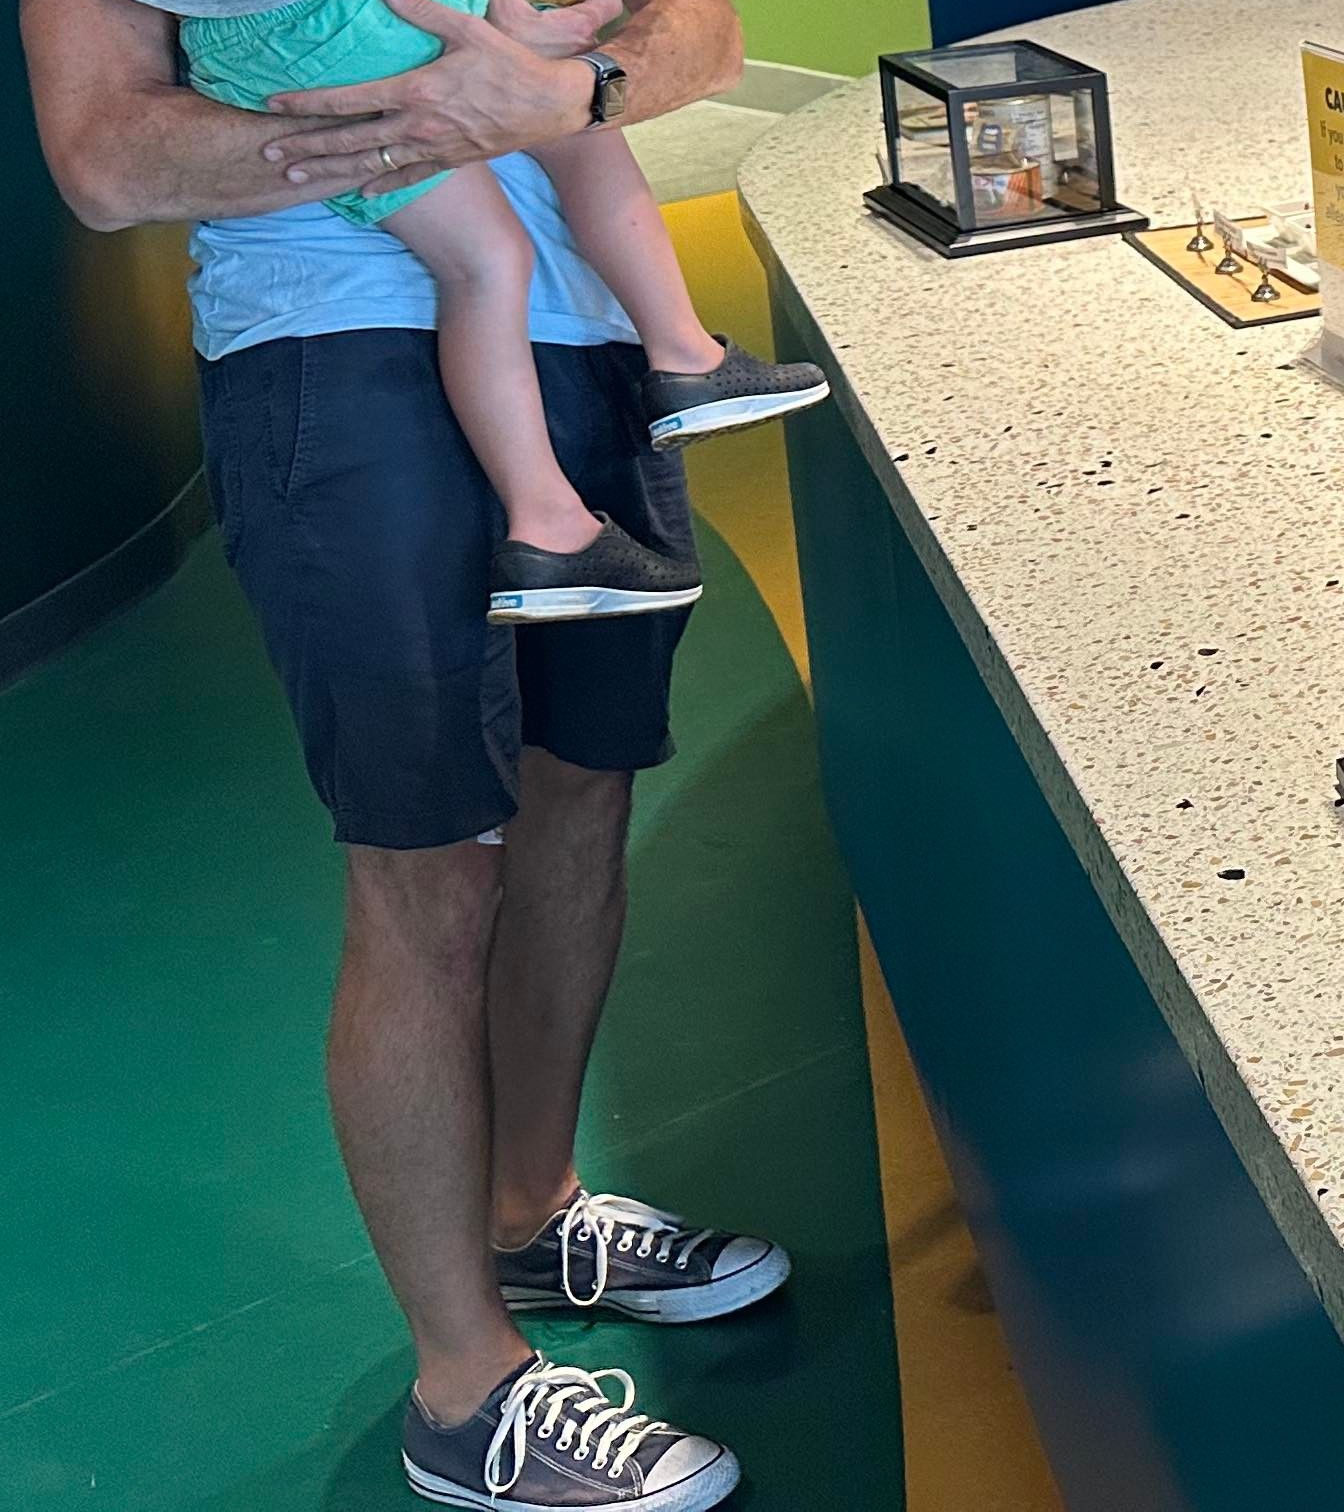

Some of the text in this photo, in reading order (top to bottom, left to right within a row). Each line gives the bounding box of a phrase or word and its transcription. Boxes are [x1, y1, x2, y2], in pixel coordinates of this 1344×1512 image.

[1319, 120, 1327, 137] If
[1327, 128, 1344, 146] you
[1334, 154, 1343, 172] to
